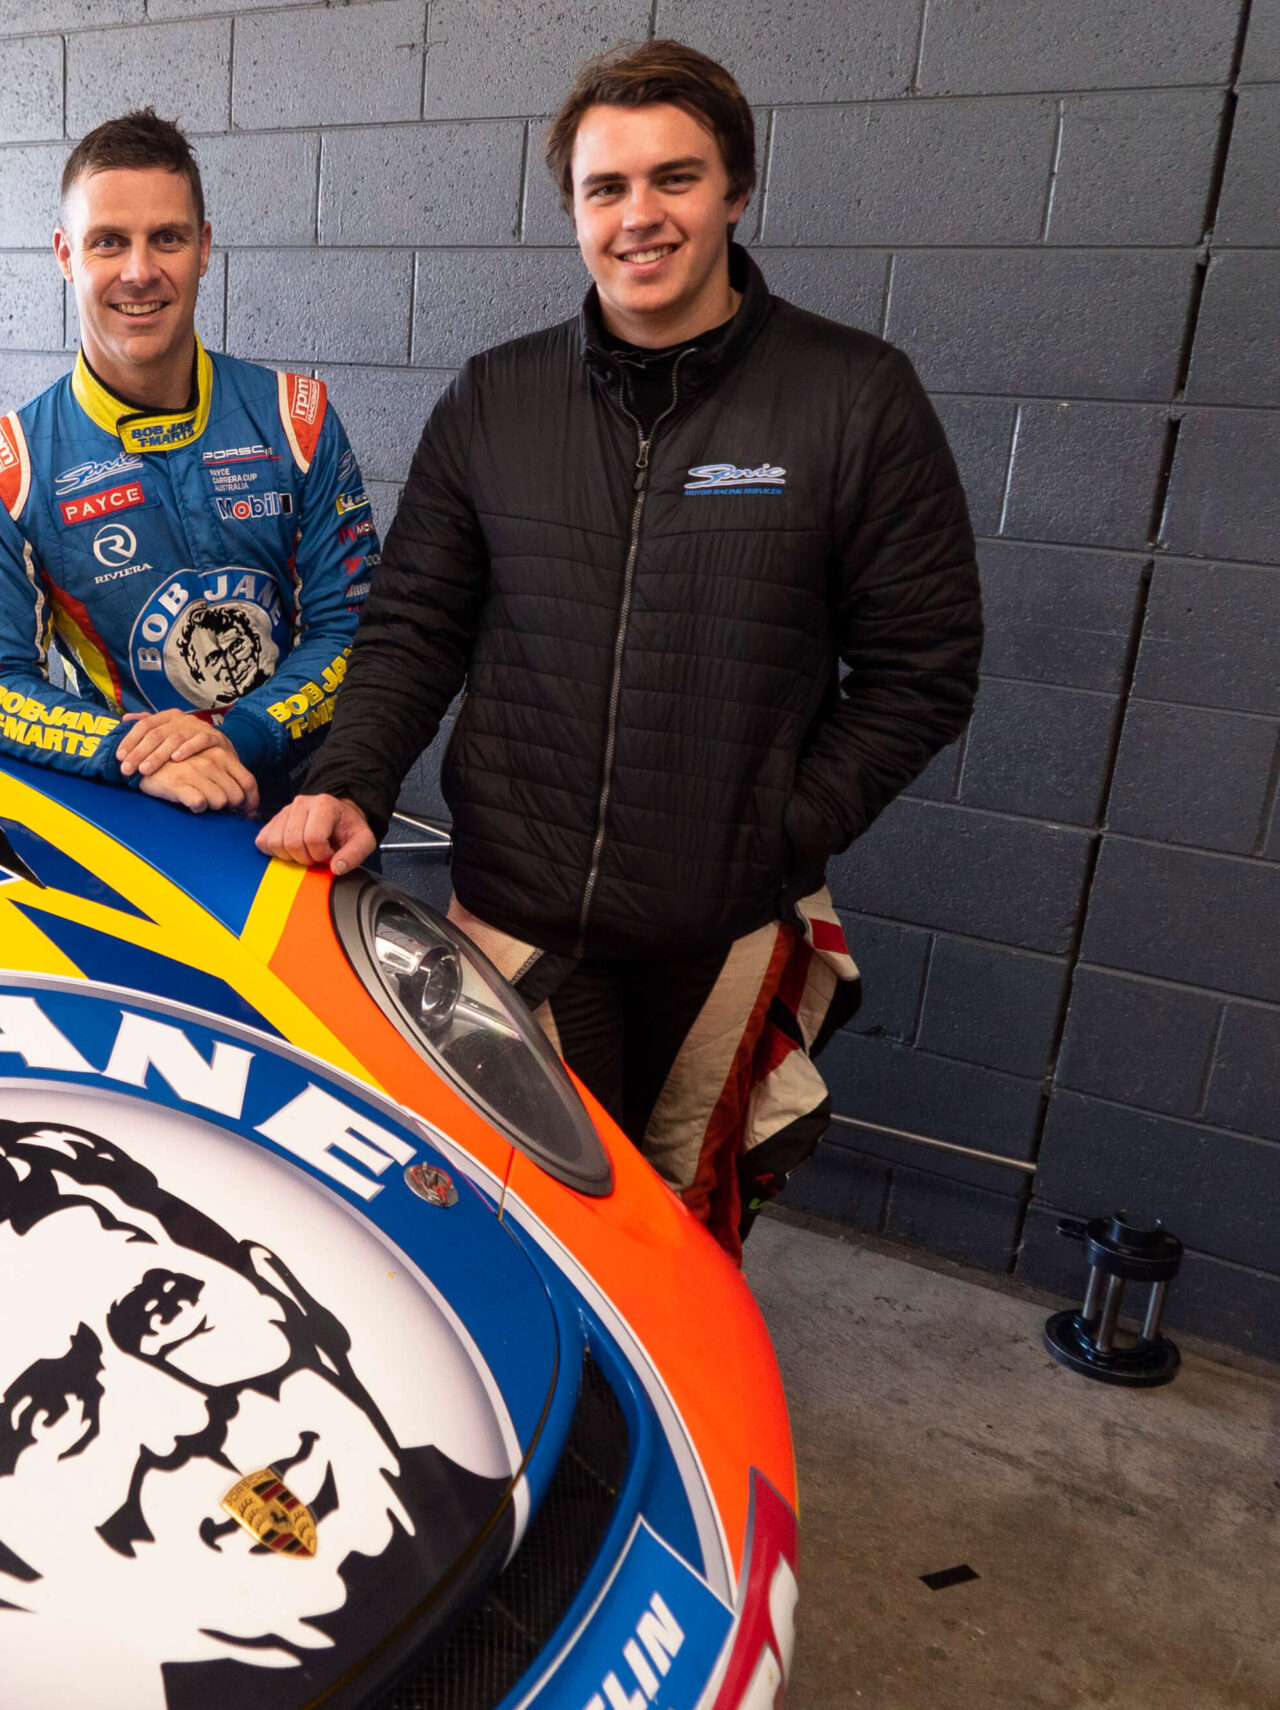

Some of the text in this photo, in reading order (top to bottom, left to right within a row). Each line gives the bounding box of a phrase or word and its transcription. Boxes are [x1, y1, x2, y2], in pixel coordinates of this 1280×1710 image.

[295, 378, 309, 416] rpm
[131, 425, 164, 439] BOB
[137, 427, 195, 448] T-MARTS
[55, 451, 143, 495] Sonic
[212, 472, 258, 485] CARRERA CUP
[684, 463, 786, 489] Sonic
[215, 482, 249, 492] AUSTRALIA
[743, 487, 783, 495] SERVICES
[65, 488, 141, 521] PAYCE
[216, 491, 280, 520] Mobil
[94, 562, 154, 585] RIVIERA
[137, 582, 189, 672] BOB
[266, 648, 352, 723] BOB JA
